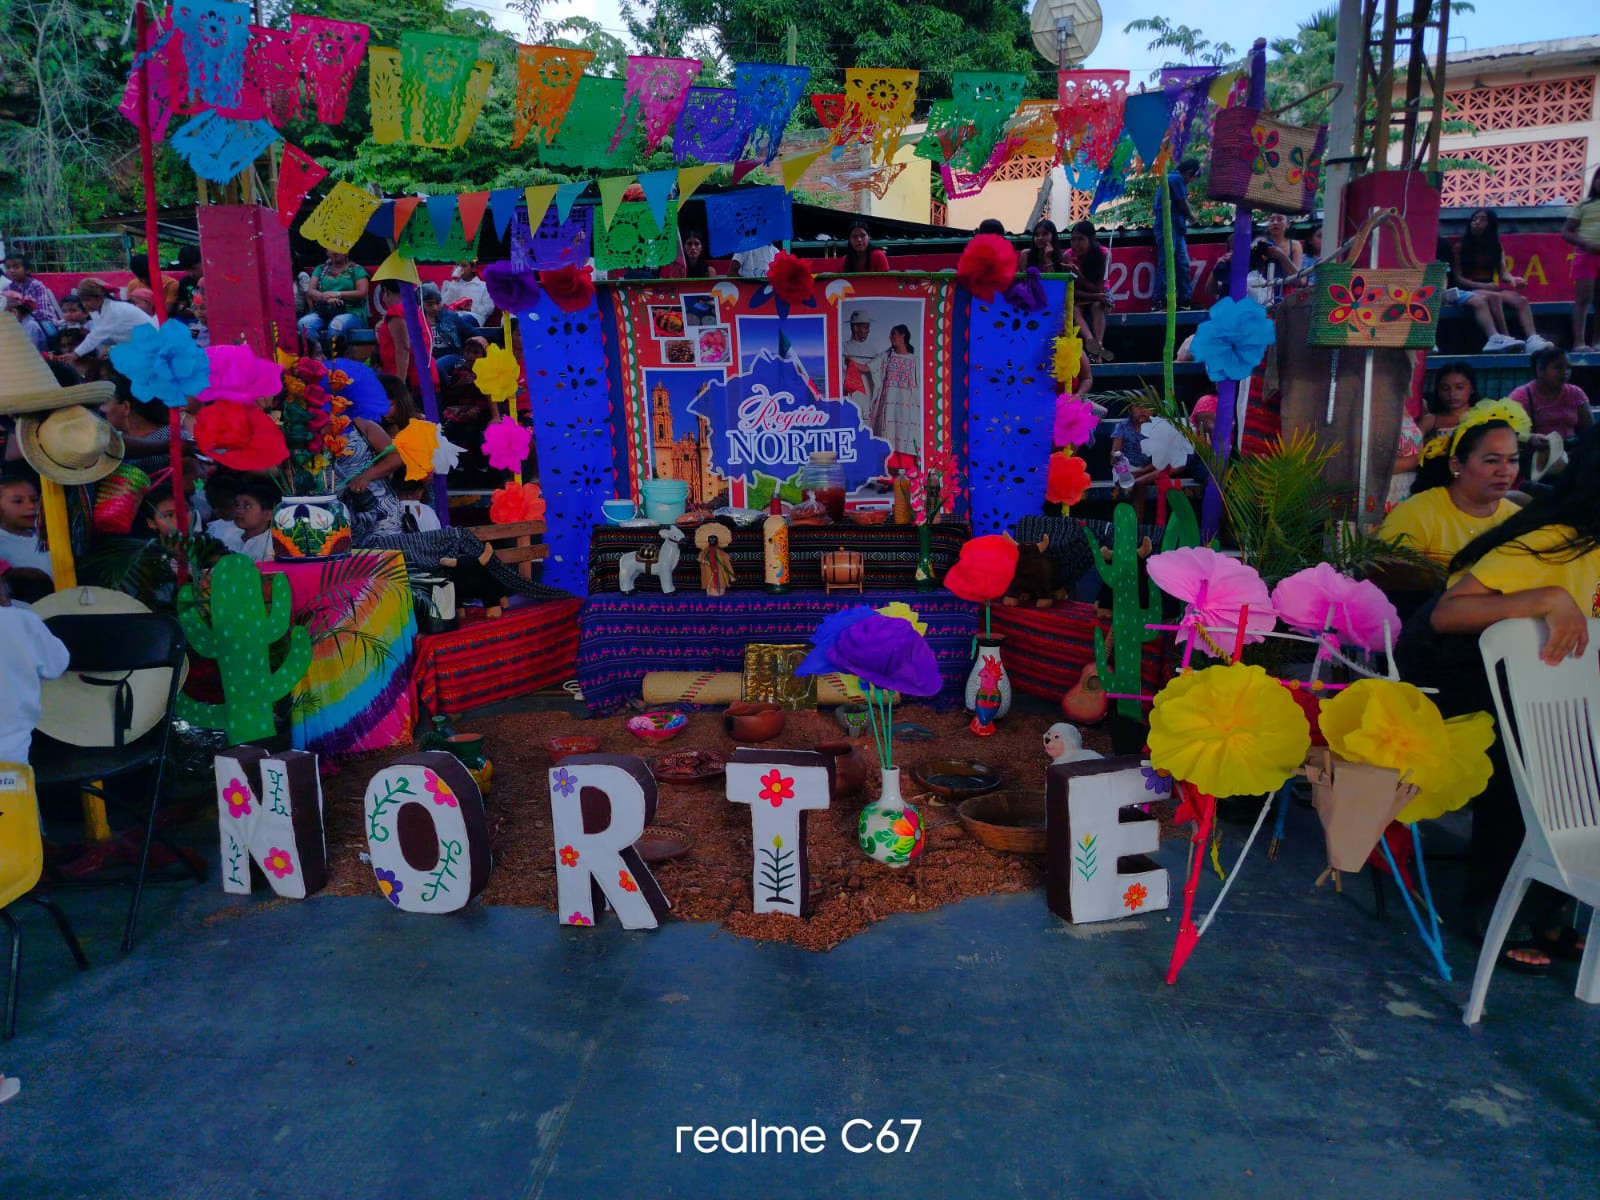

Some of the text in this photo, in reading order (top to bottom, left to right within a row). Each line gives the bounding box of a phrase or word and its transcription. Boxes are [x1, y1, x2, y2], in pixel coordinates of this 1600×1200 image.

[1109, 260, 1207, 300] 207
[738, 384, 829, 433] Región
[726, 427, 857, 465] NORTE
